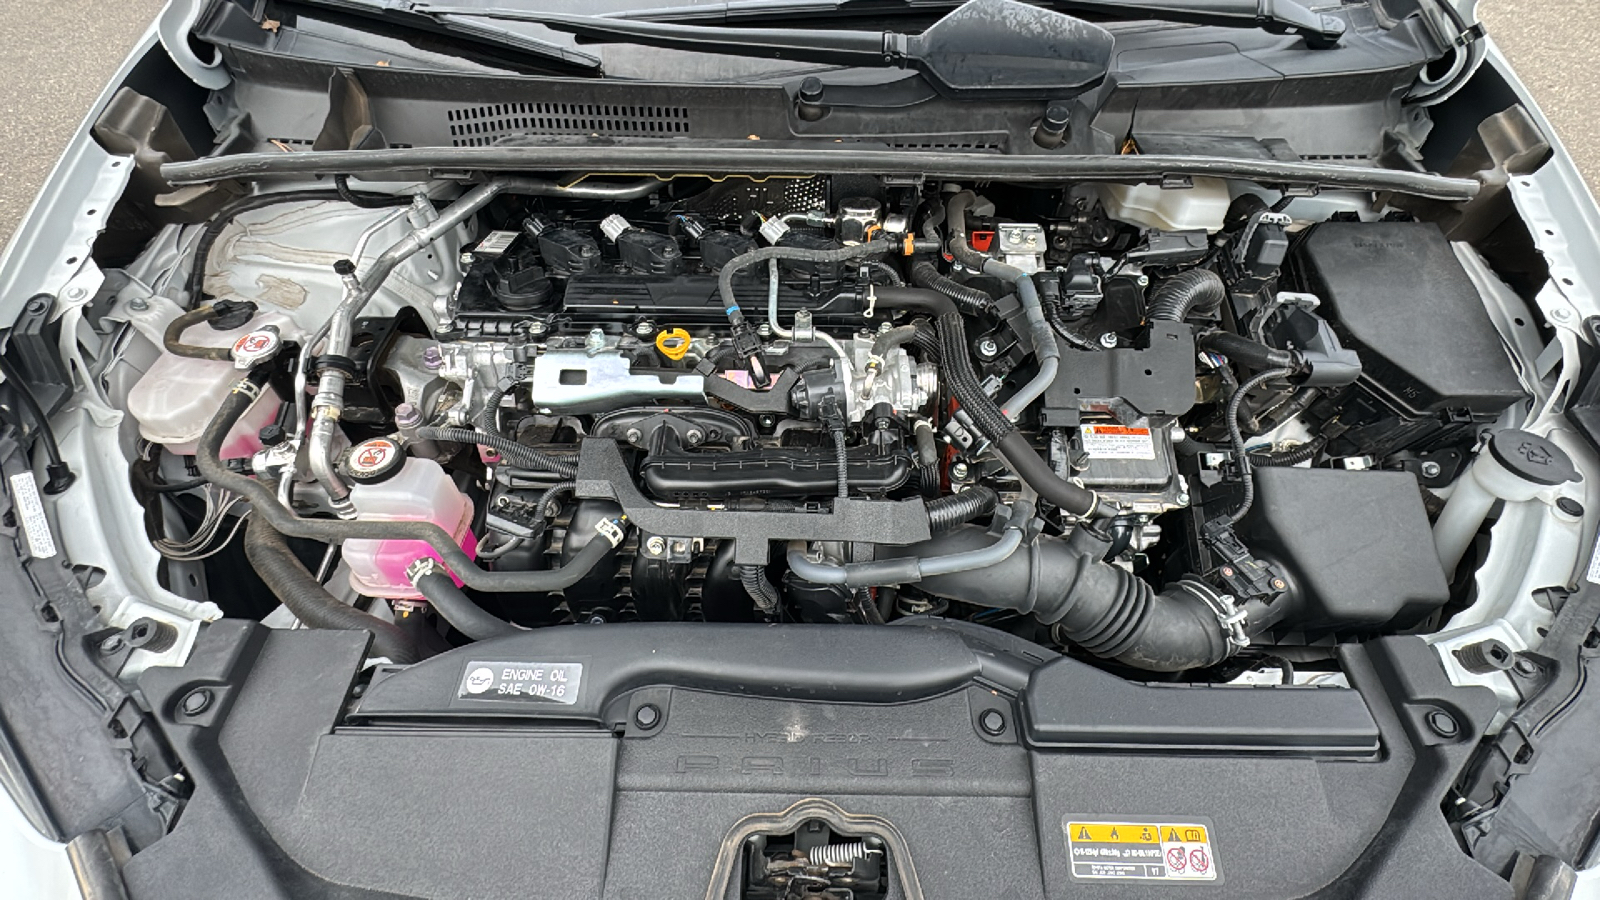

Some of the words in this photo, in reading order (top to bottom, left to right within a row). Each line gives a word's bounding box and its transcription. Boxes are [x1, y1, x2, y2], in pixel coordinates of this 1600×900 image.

[501, 668, 543, 680] ENGINE
[550, 669, 568, 682] OIL
[498, 683, 523, 695] SAE
[529, 684, 566, 696] 0W-16
[674, 755, 955, 776] PRIUS
